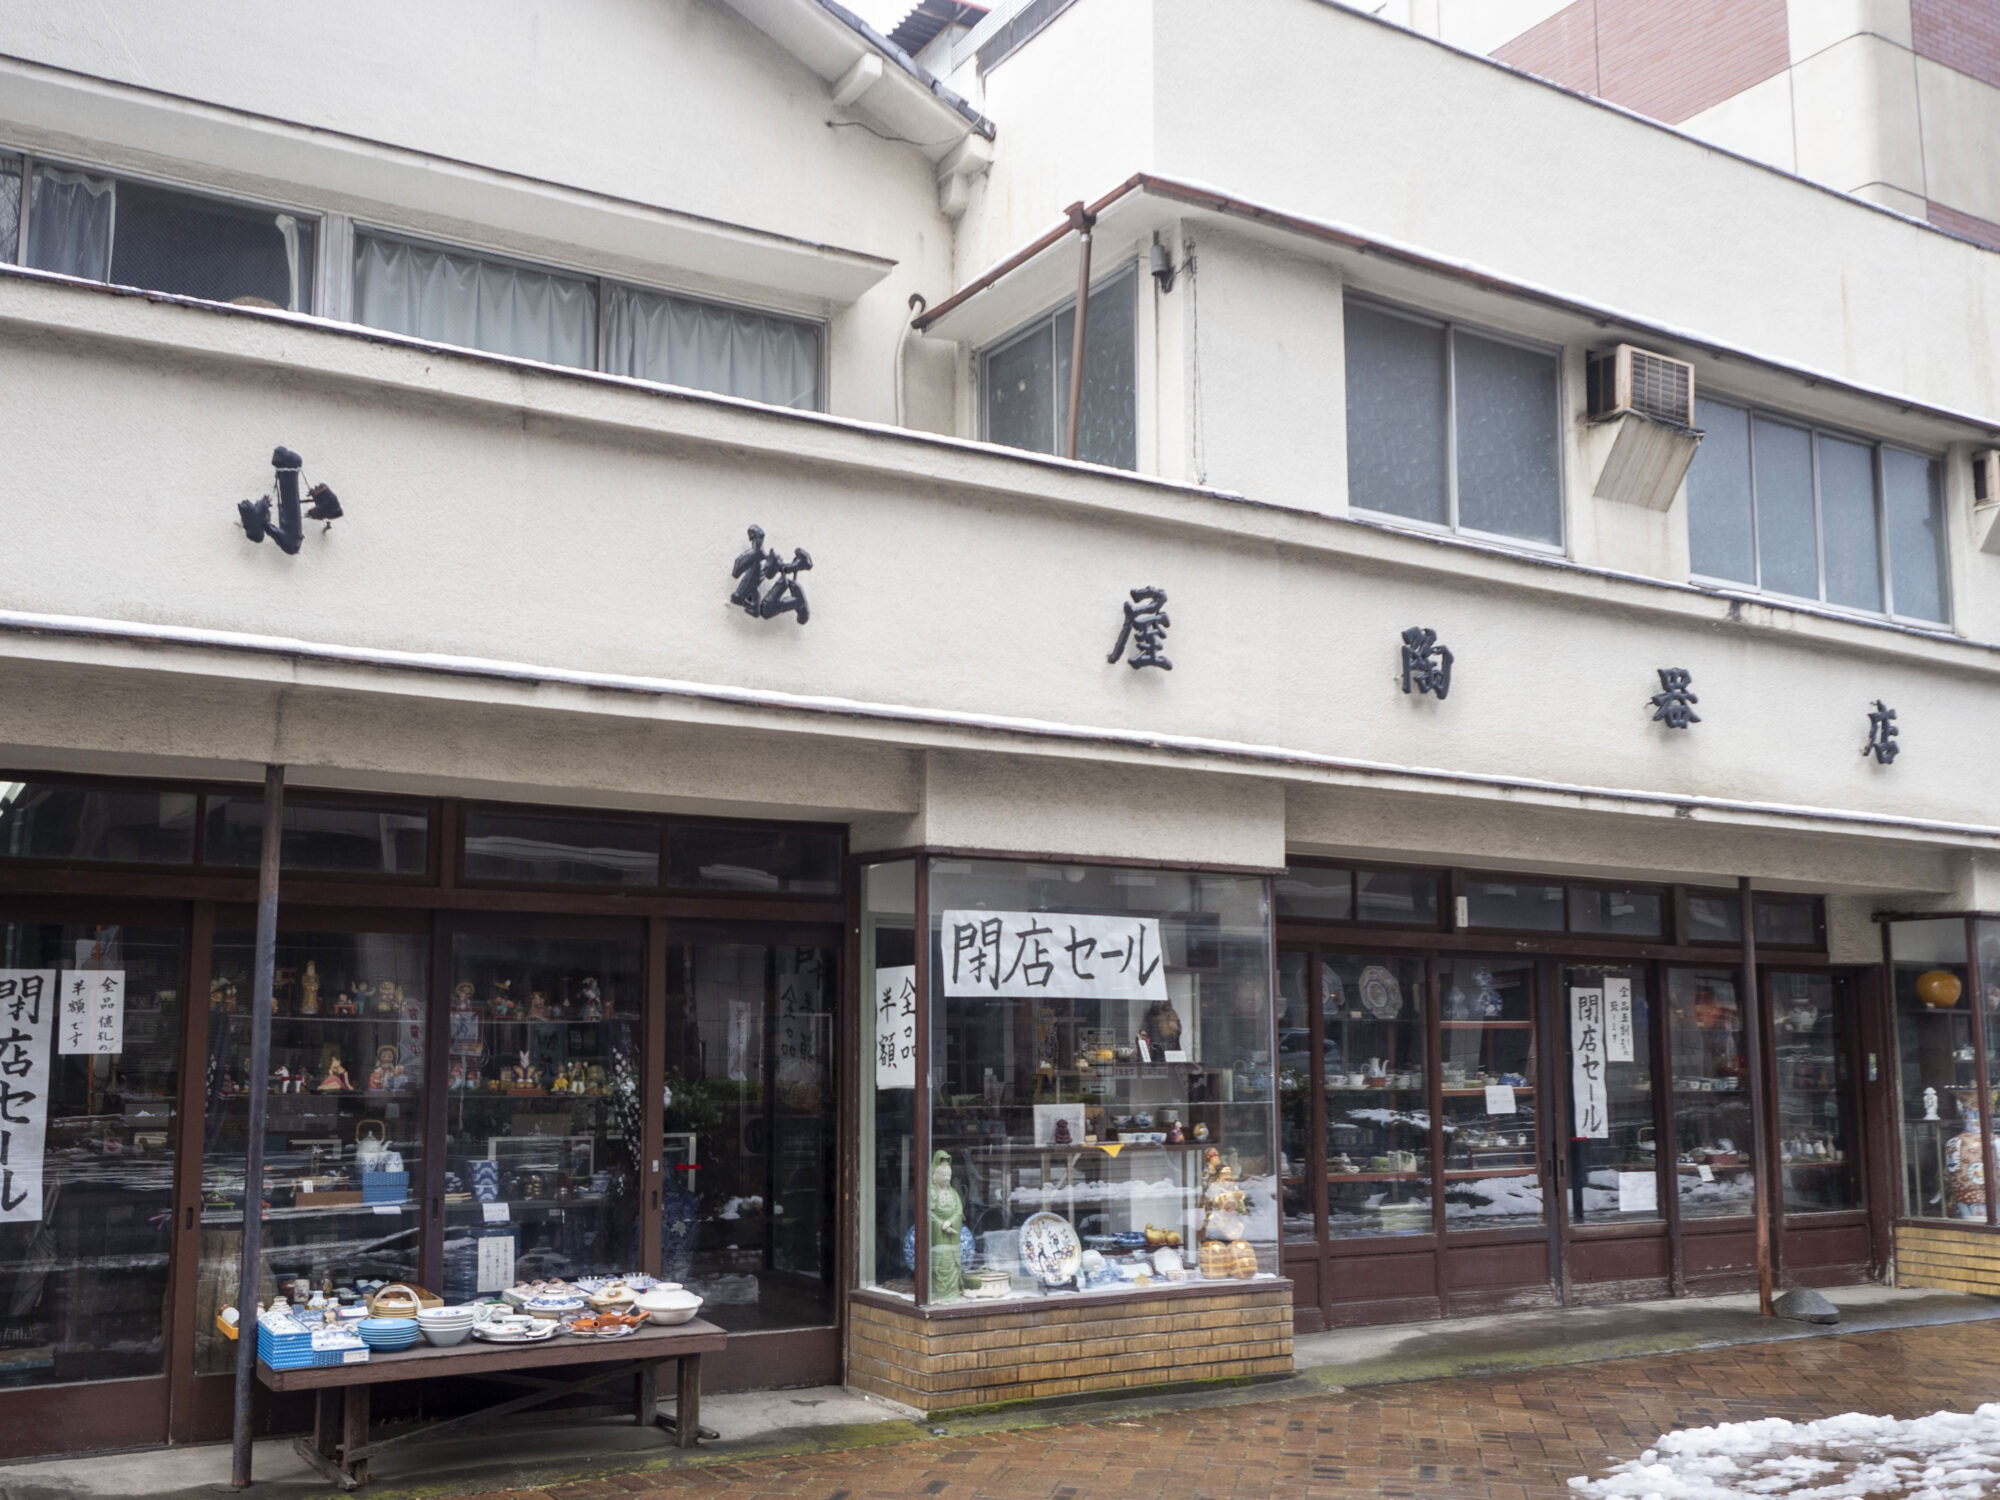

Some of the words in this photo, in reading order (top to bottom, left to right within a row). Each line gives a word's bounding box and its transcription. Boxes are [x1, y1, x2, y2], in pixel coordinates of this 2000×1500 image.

[953, 917, 1160, 990] 閉店セール
[67, 979, 86, 1047] 半額です
[879, 986, 897, 1068] 半額
[900, 976, 915, 1058] 全品
[1578, 994, 1602, 1132] 閉店セール
